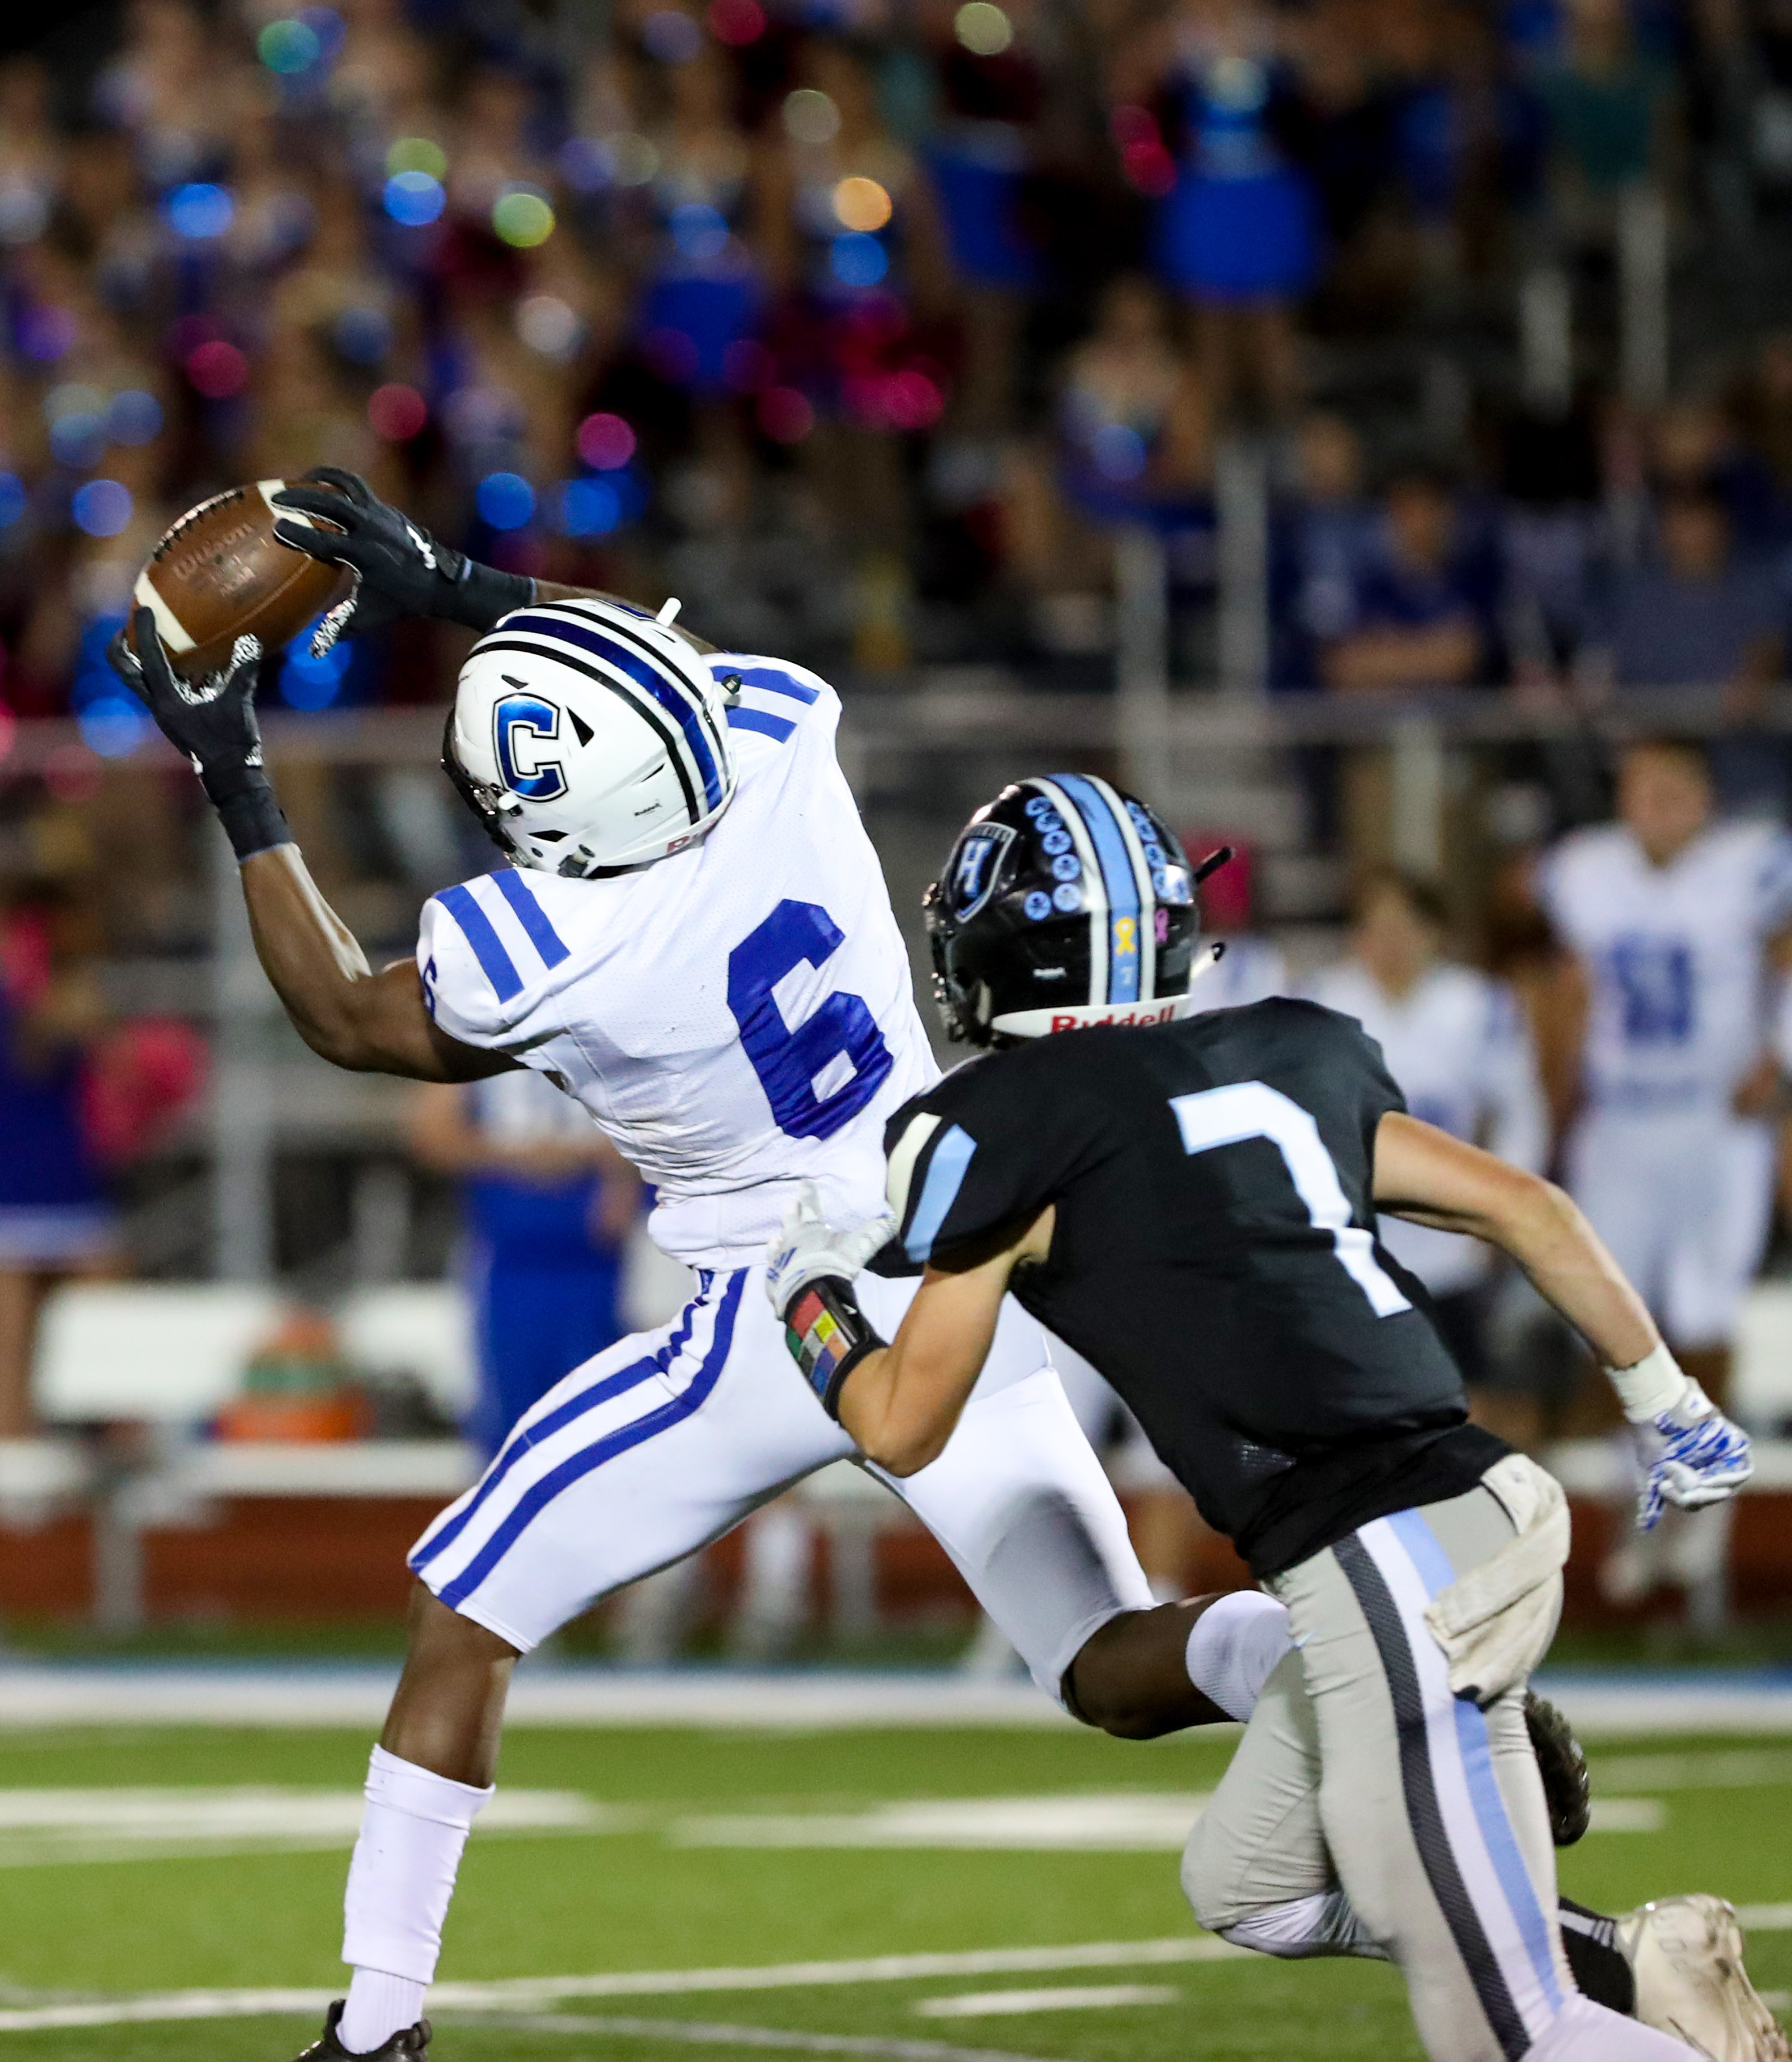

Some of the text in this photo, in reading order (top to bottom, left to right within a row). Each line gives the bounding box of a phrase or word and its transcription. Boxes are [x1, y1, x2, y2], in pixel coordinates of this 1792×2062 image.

[492, 692, 569, 802] C
[953, 837, 994, 898] H
[728, 898, 894, 1141] 6
[1168, 1079, 1413, 1319] 7
